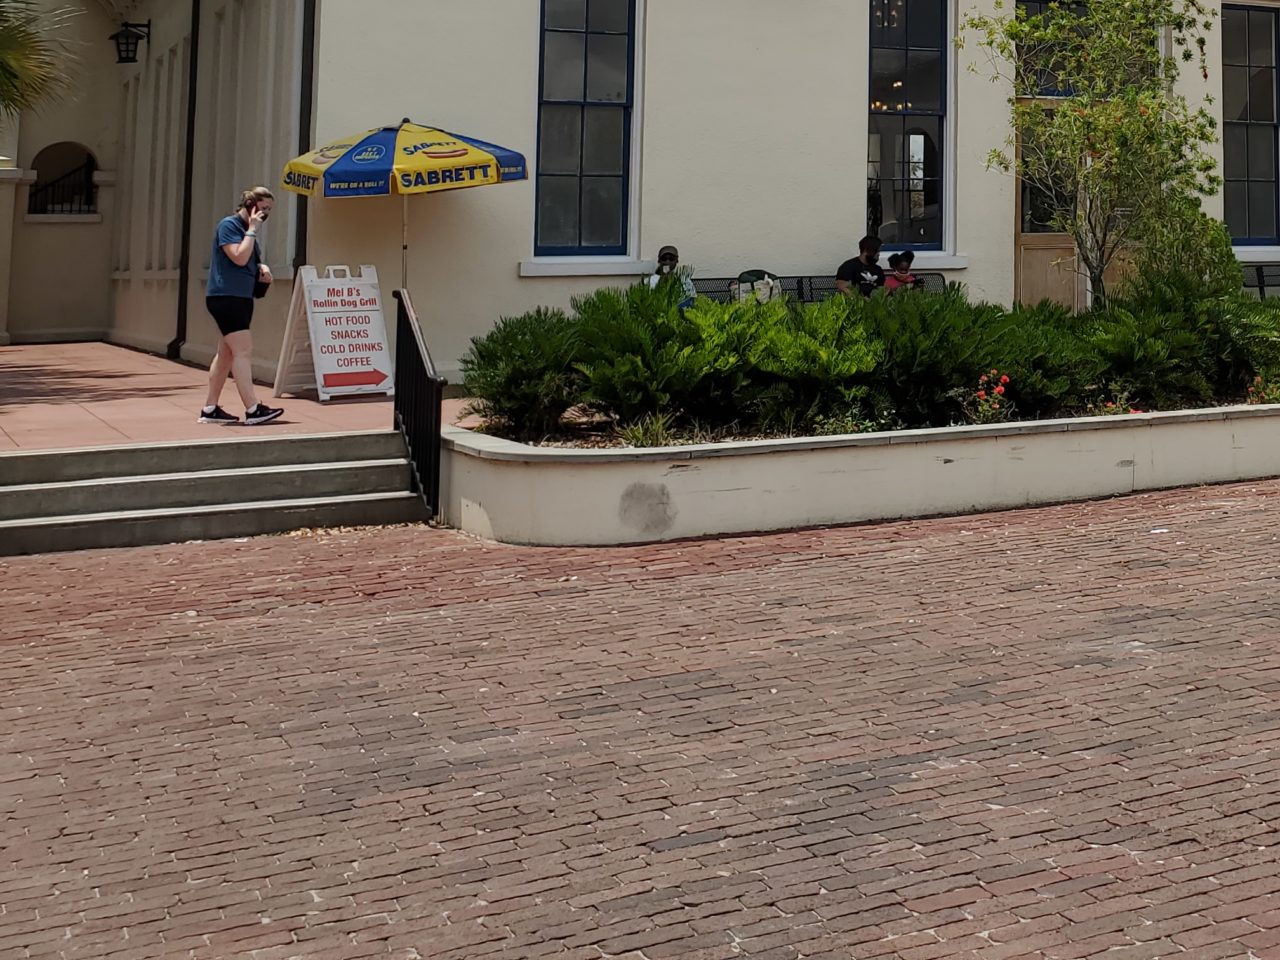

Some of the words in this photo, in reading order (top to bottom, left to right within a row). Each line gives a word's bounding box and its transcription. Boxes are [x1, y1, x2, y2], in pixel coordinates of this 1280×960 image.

[402, 141, 457, 156] SABRETT
[401, 164, 491, 188] SABRETT
[327, 287, 344, 298] Mel
[347, 287, 361, 297] B's
[313, 299, 338, 308] Rollin
[340, 299, 357, 309] Dog
[359, 297, 377, 307] Grill
[325, 316, 343, 327] HOT
[346, 315, 371, 326] FOOD
[331, 329, 369, 340] SNACKS
[320, 344, 345, 355] COLD
[348, 342, 383, 353] DRINKS
[336, 356, 372, 368] COFFEE
